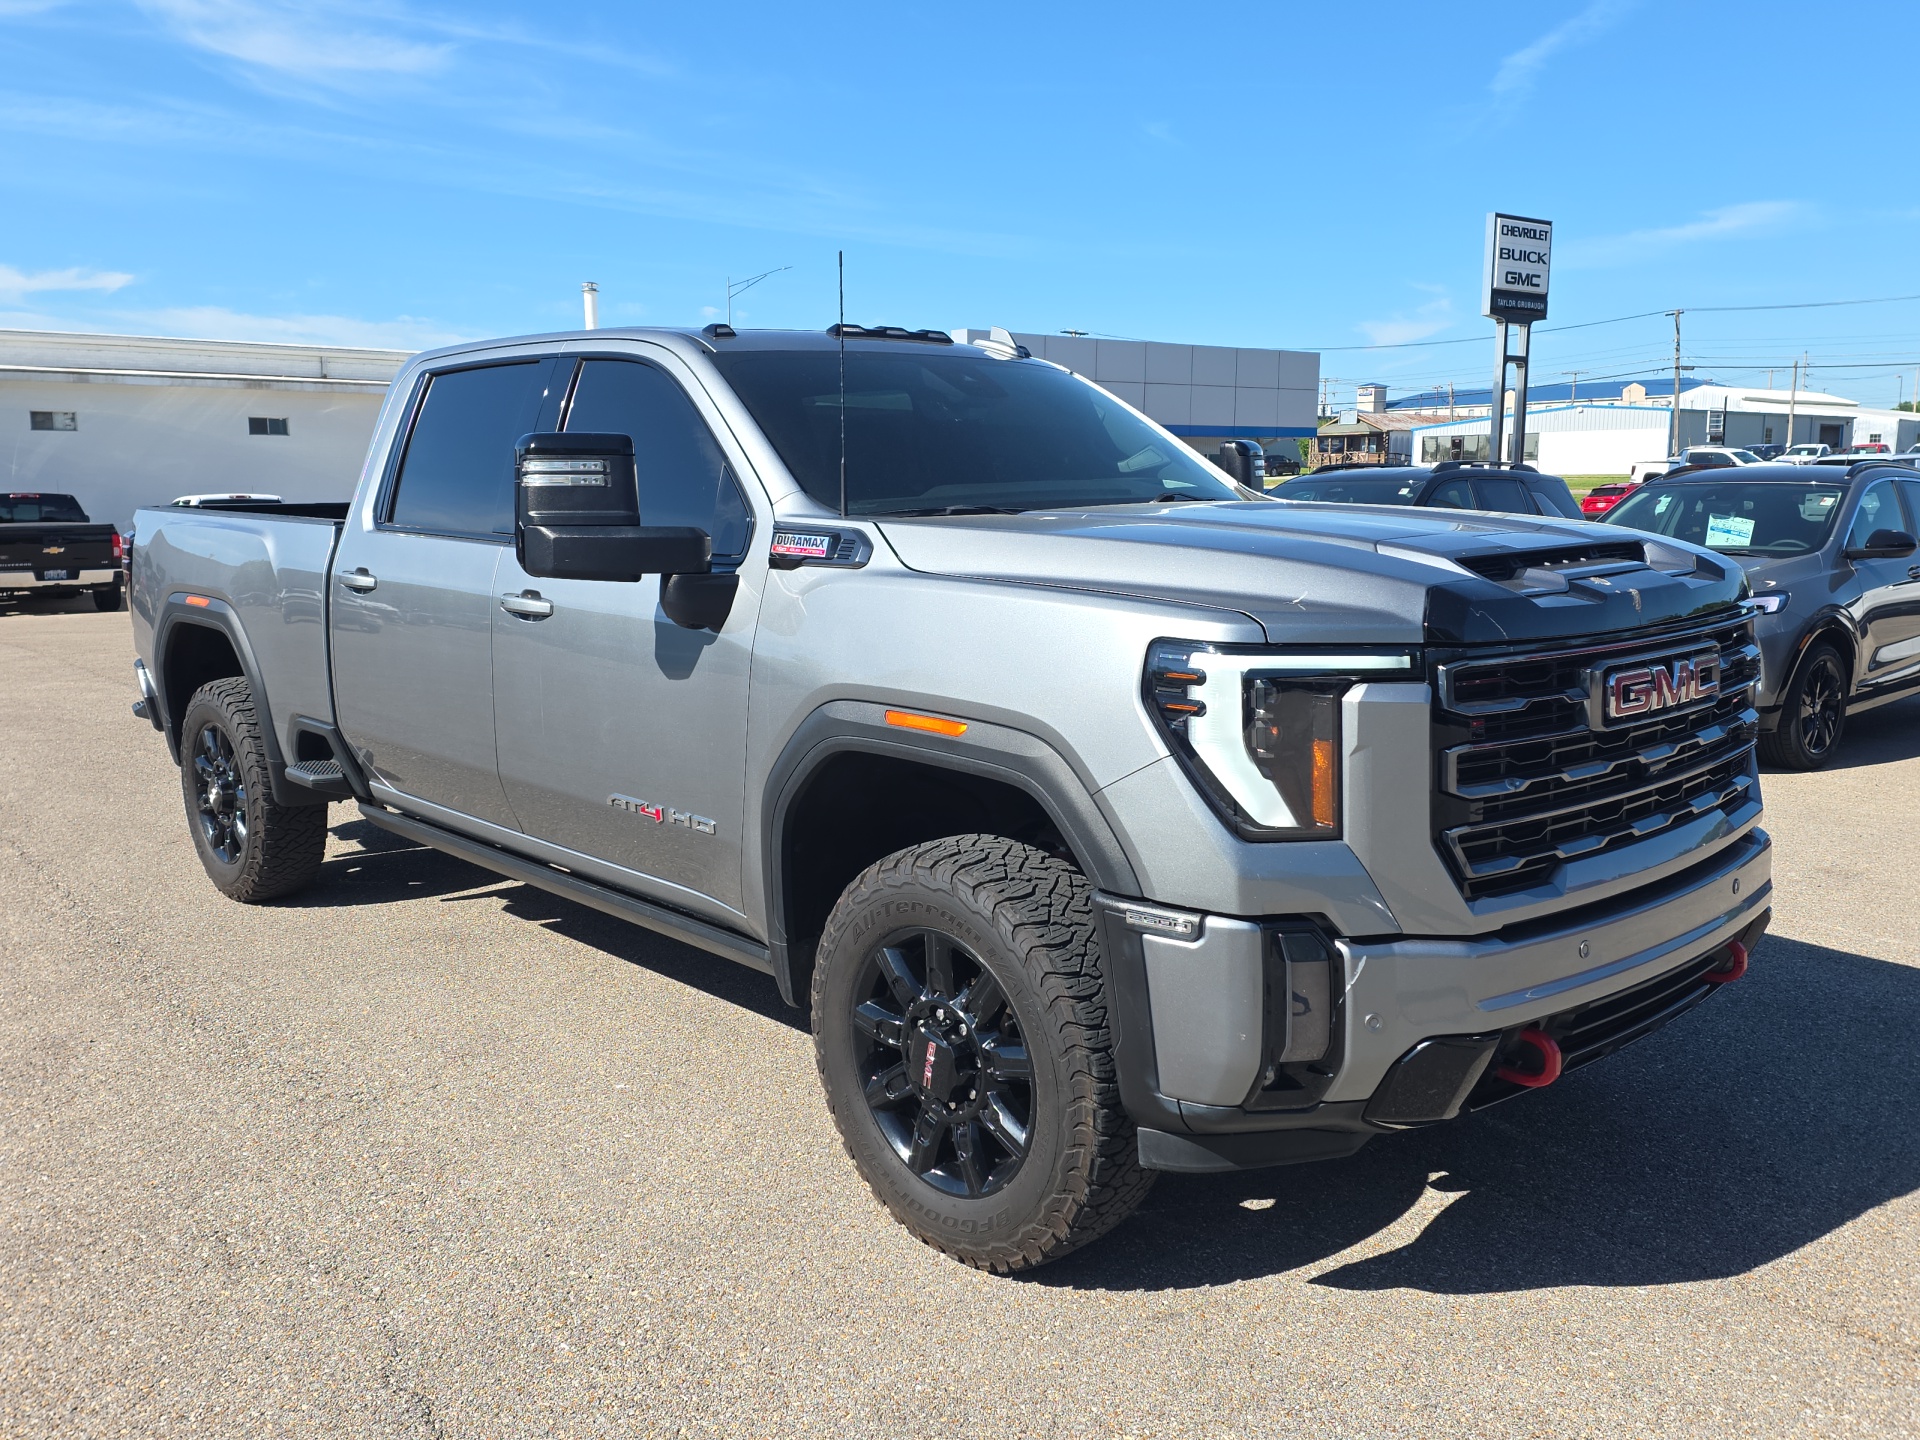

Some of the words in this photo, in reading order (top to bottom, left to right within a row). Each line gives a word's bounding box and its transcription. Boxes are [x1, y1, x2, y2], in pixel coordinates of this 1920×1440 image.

[1501, 224, 1549, 241] CHEVROLET
[1499, 247, 1547, 265] BUICK
[1505, 271, 1541, 287] GMC
[1497, 298, 1516, 307] TAYLOR
[1517, 300, 1545, 310] GRUBAUGH
[776, 534, 825, 548] DURAMAX
[1607, 653, 1721, 718] GMC
[922, 1041, 937, 1090] GMC
